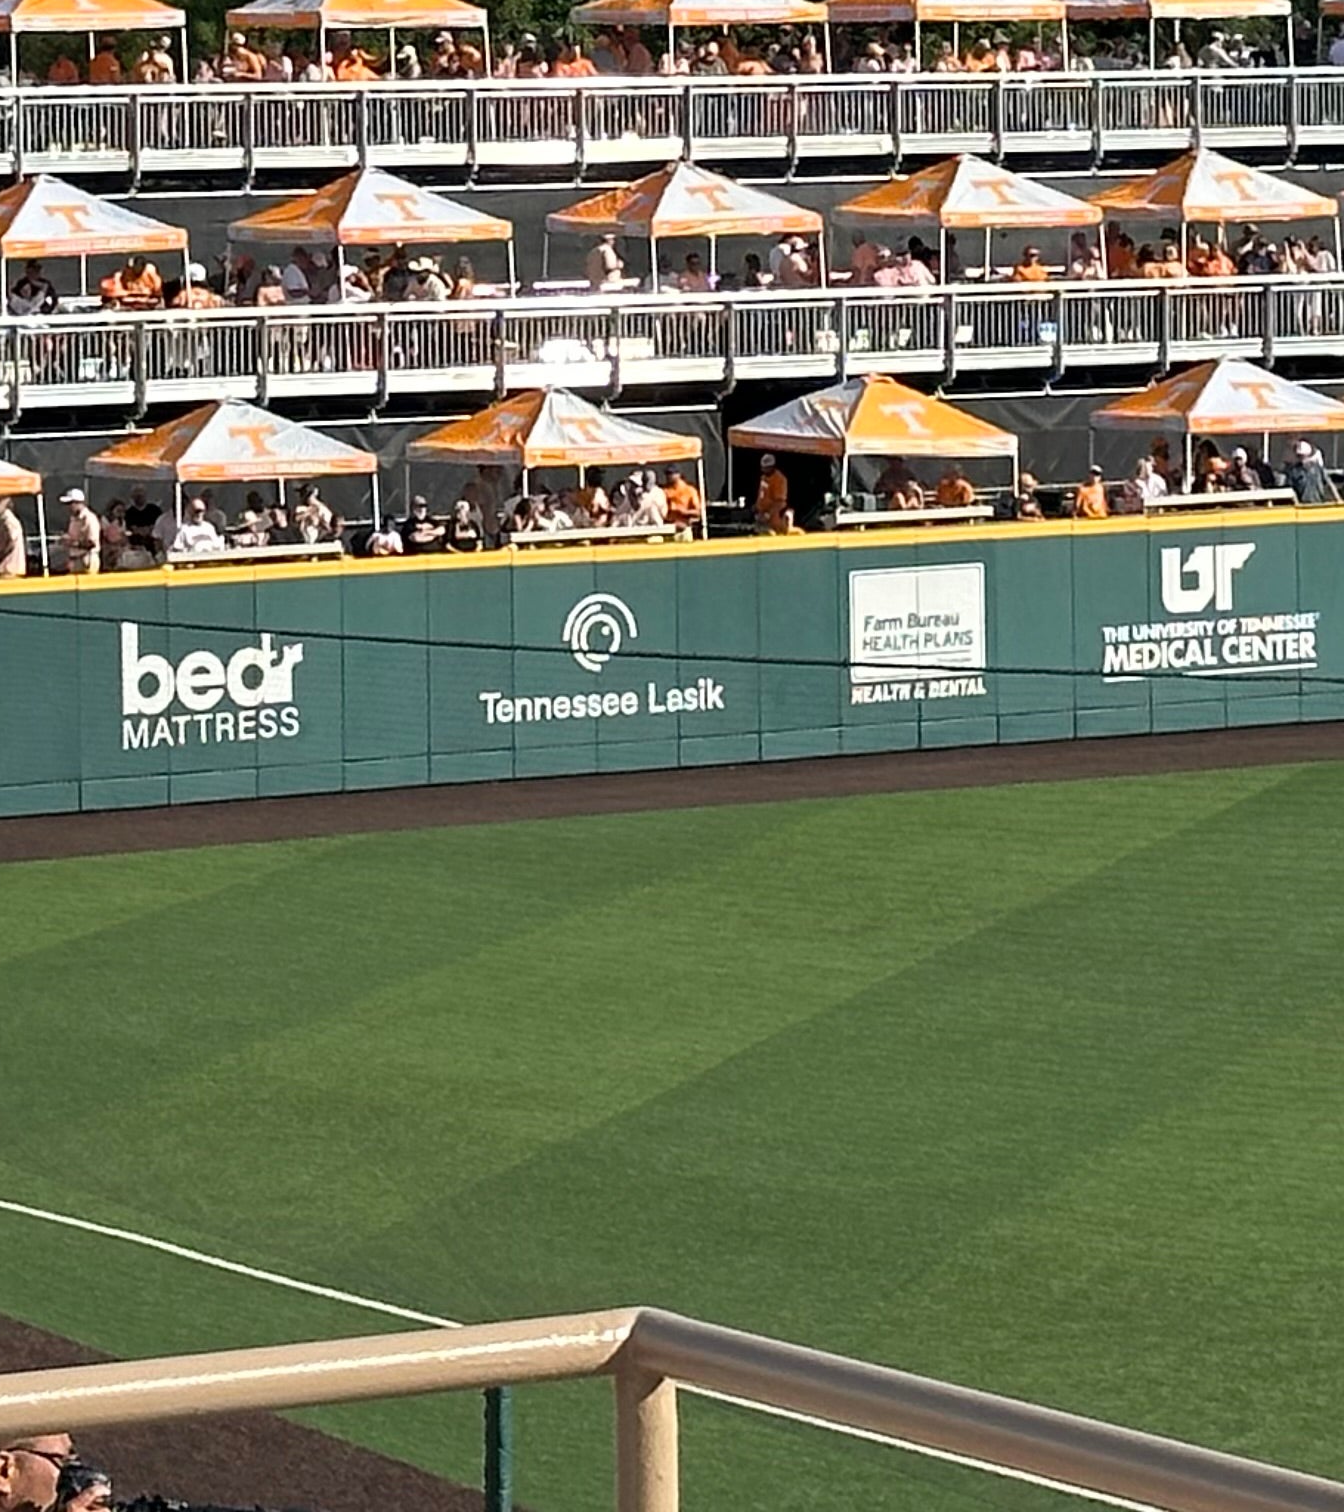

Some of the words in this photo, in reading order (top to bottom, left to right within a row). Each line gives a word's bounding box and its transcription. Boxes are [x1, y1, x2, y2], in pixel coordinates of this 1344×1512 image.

[1161, 542, 1256, 614] UT
[864, 615, 903, 632] Farm
[907, 612, 960, 629] Bureau
[1102, 624, 1131, 643] THE
[1132, 619, 1216, 640] UNIVERSITY
[1216, 618, 1238, 636] OF
[862, 633, 919, 651] HEALTH
[924, 629, 974, 649] PLANS
[1102, 639, 1218, 674] MEDICAL
[1222, 631, 1317, 664] CENTER
[479, 691, 639, 724] Tennessee
[647, 678, 725, 714] Lasik
[851, 682, 909, 705] HEALTH
[928, 677, 988, 702] DENTAL
[122, 706, 300, 750] MATTRESS
